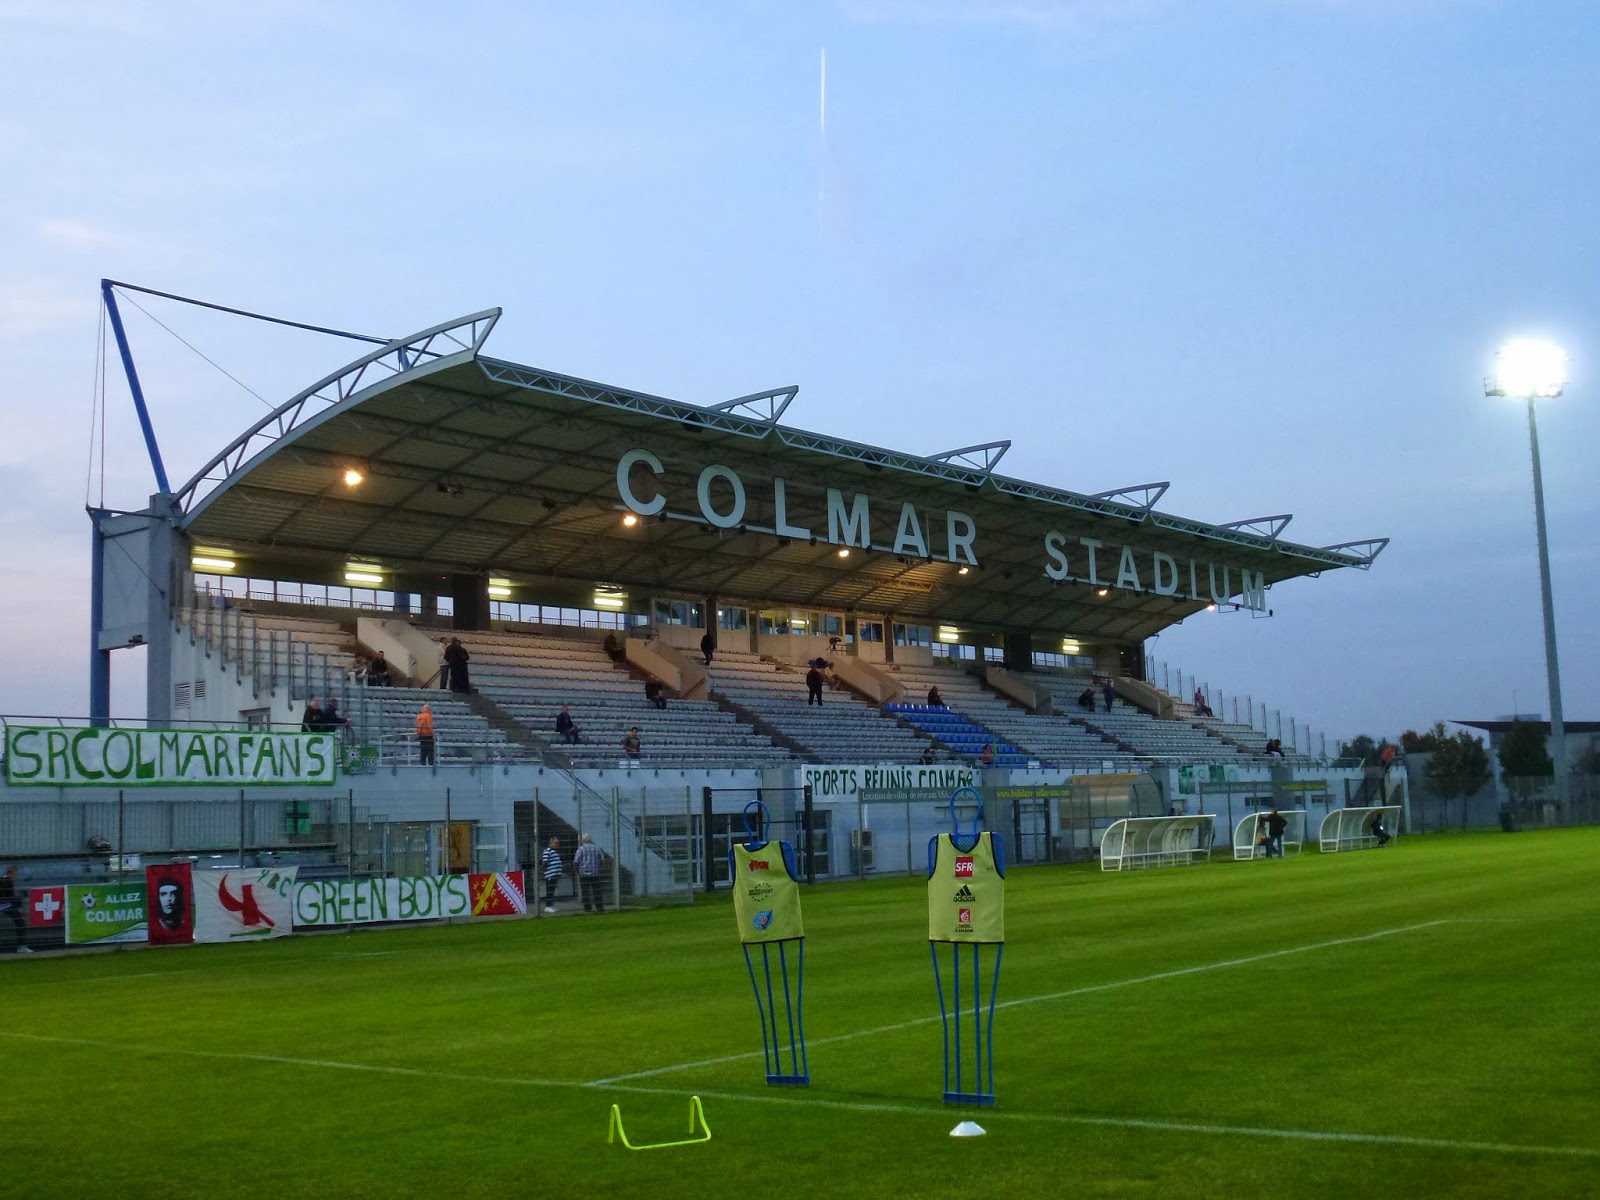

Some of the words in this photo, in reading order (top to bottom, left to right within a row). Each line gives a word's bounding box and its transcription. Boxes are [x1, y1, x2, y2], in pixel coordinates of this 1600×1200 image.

[616, 448, 979, 566] COLMAR
[1044, 529, 1266, 612] STADIUM
[806, 769, 857, 795] SPORTS
[862, 791, 886, 800] Location
[887, 791, 893, 799] de
[955, 862, 973, 872] SFR
[105, 892, 141, 904] ALLEZ
[297, 877, 388, 925] GREEN
[399, 874, 467, 919] BOYS
[85, 907, 143, 923] COLMAR
